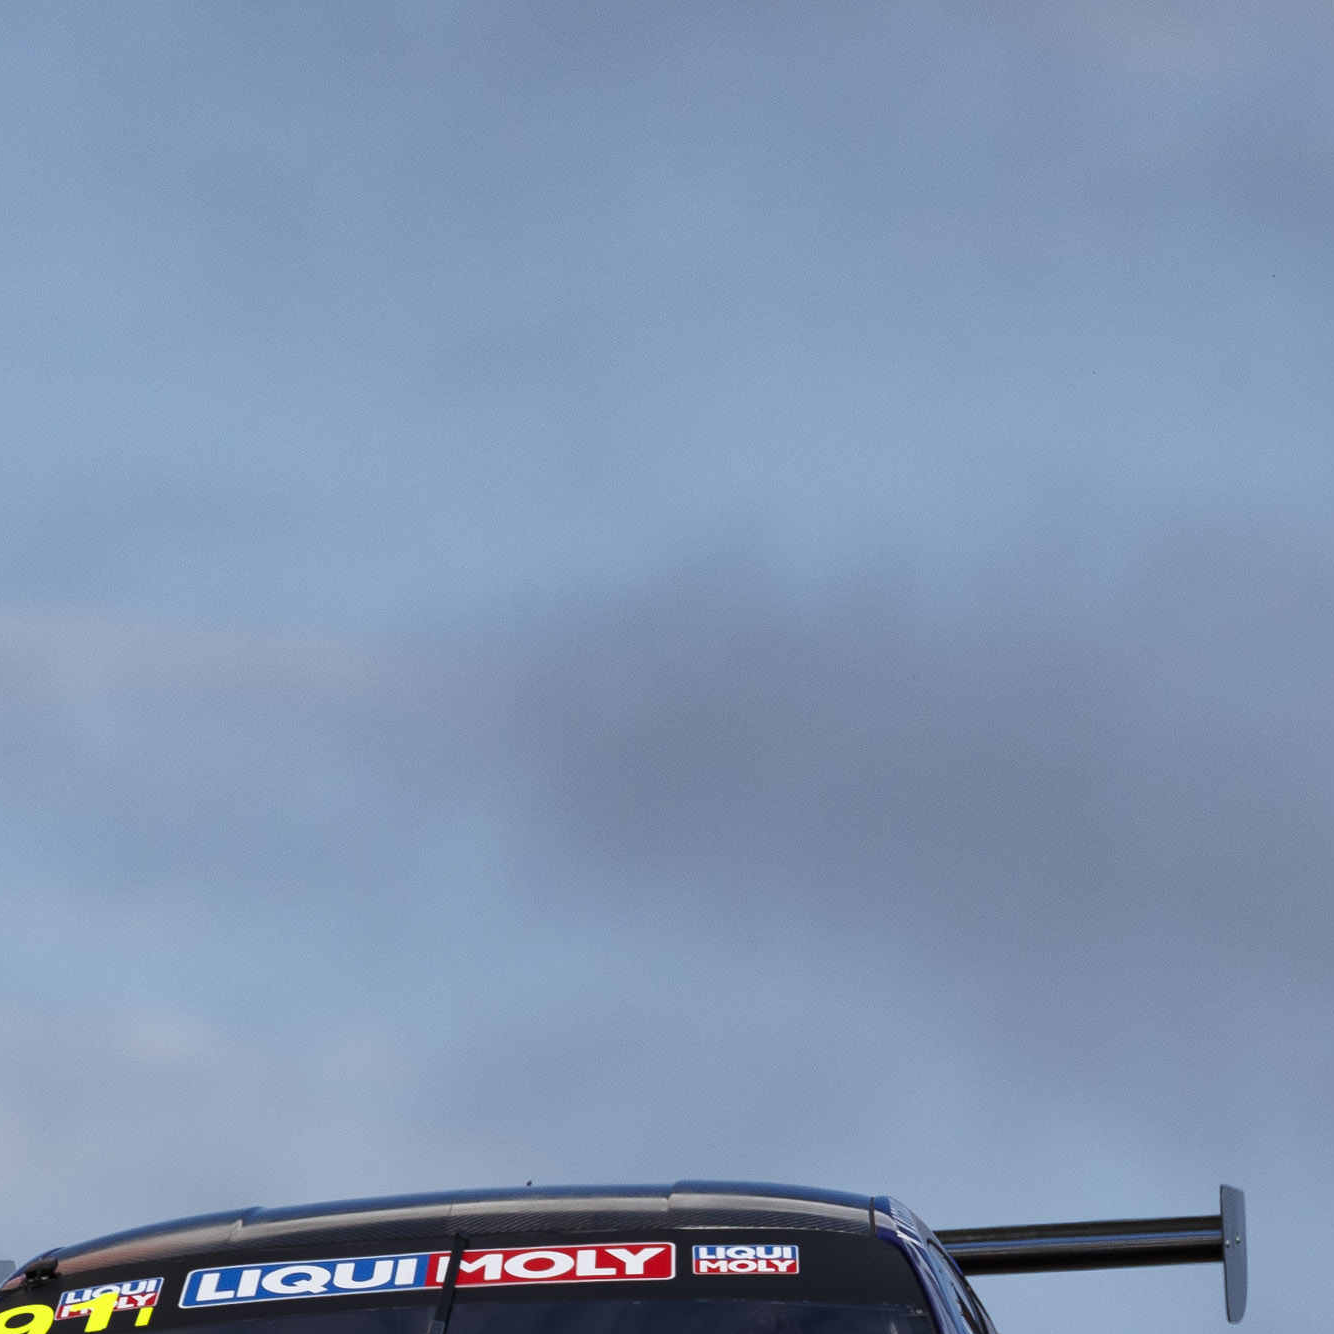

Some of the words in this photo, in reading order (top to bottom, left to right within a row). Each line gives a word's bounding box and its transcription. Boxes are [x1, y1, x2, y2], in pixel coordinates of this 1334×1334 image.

[698, 1246, 793, 1260] LIQUI
[699, 1260, 796, 1273] MOLY
[194, 1257, 419, 1302] LIQUI
[435, 1246, 666, 1283] MOLY
